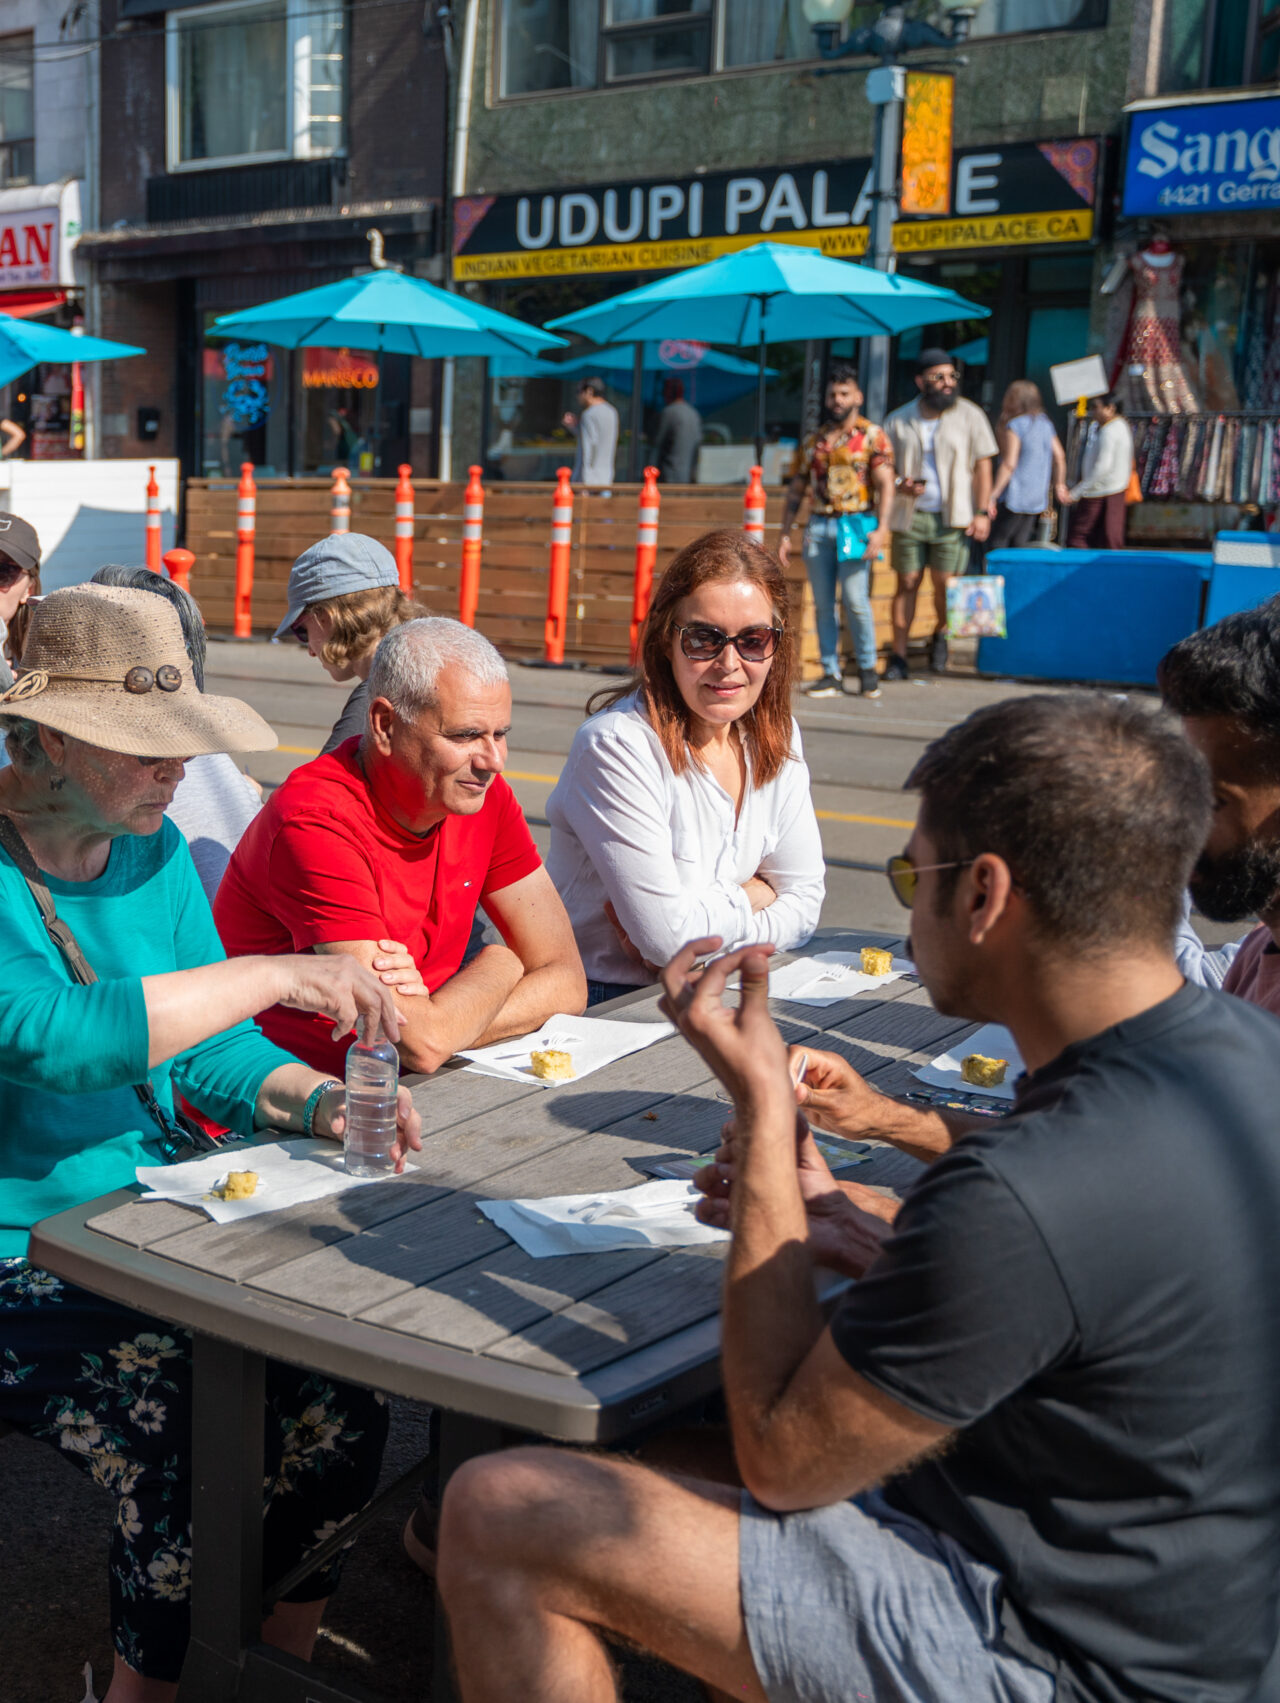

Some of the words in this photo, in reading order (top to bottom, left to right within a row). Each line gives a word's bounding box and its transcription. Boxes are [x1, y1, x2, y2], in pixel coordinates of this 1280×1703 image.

[515, 182, 704, 250] UDUPI
[725, 153, 1003, 236] PALAE
[1157, 183, 1210, 207] 1421
[460, 254, 518, 276] INDIAN
[521, 248, 635, 273] VEGETARIAN
[642, 242, 714, 264] CUISINE
